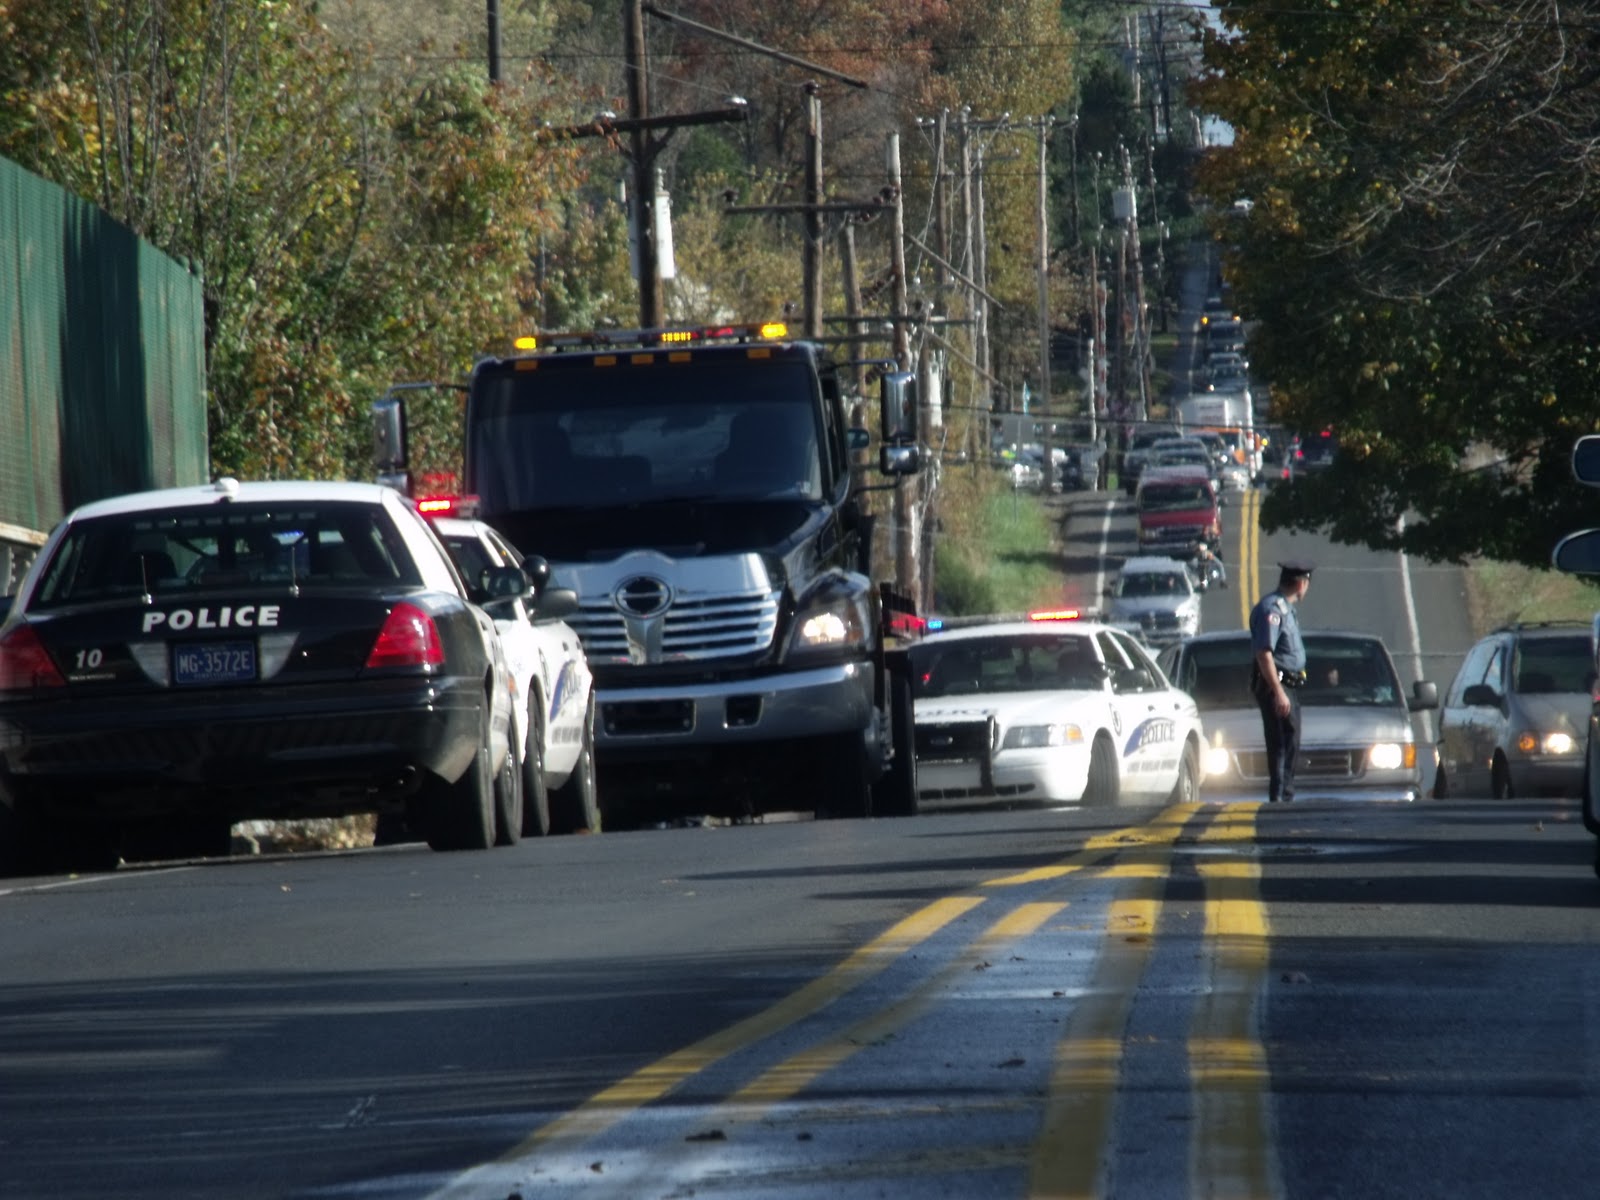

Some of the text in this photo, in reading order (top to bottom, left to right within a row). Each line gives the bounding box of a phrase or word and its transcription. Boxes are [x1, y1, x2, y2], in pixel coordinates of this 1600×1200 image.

[142, 605, 280, 632] POLICE
[77, 649, 102, 669] 10
[1141, 721, 1175, 746] POLICE
